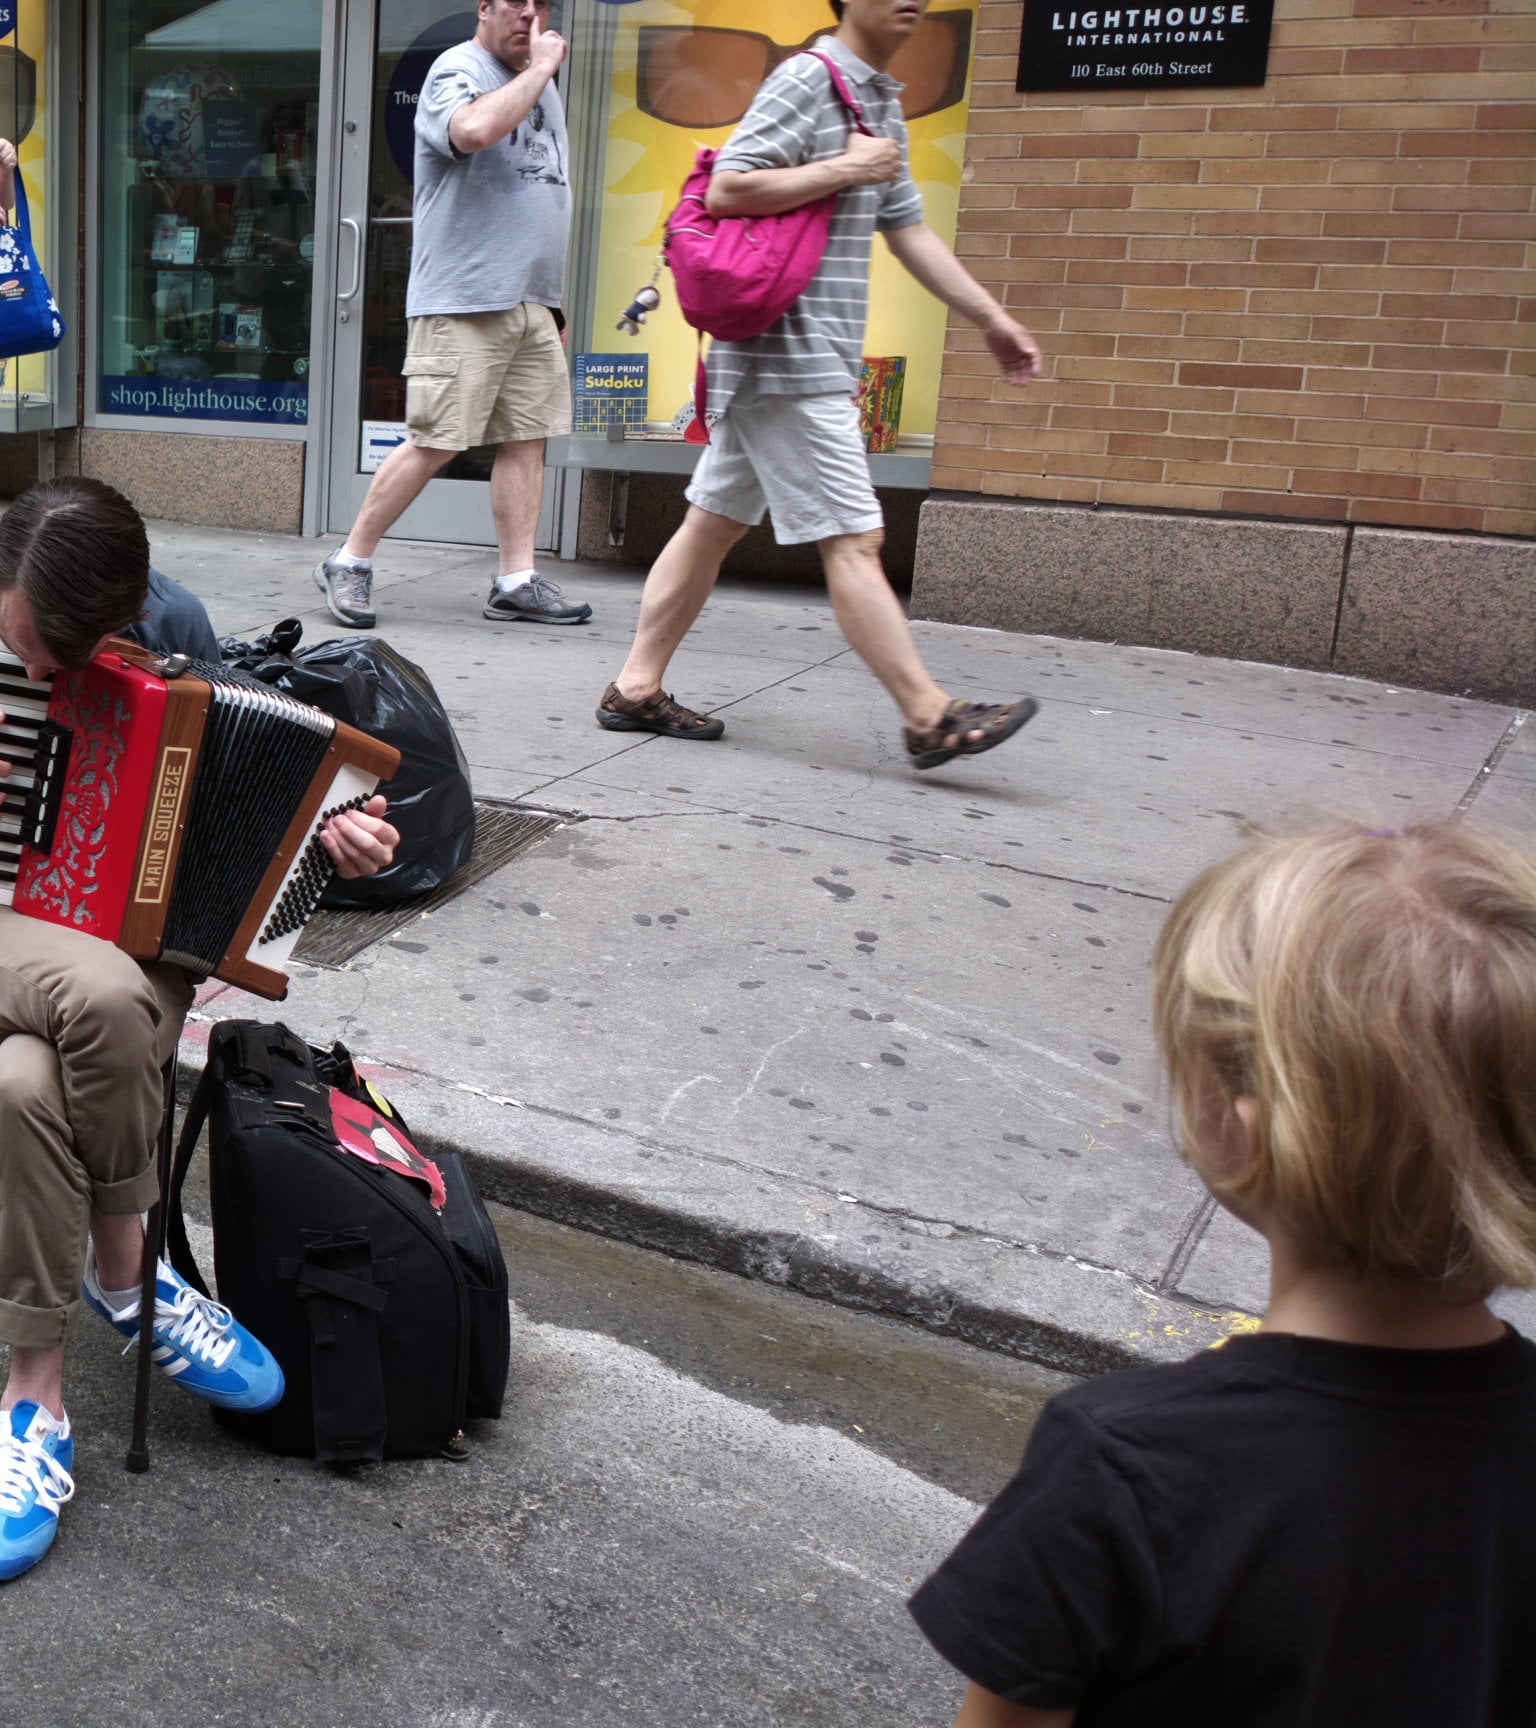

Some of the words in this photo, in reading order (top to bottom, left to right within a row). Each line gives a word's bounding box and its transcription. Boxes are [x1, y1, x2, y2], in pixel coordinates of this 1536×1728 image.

[1052, 5, 1246, 30] LIGHTHOUSE
[1067, 30, 1225, 46] INTERNATIONAL
[1071, 64, 1089, 77] 110
[1095, 63, 1126, 77] East
[1131, 62, 1163, 76] 60th
[1168, 61, 1212, 75] Street
[394, 90, 418, 104] The
[617, 365, 644, 373] PRINT
[585, 374, 644, 389] Sudoku
[111, 385, 308, 418] shop.lighthouse.org
[154, 765, 183, 842] SQUEEZE
[144, 849, 165, 887] MAIN
